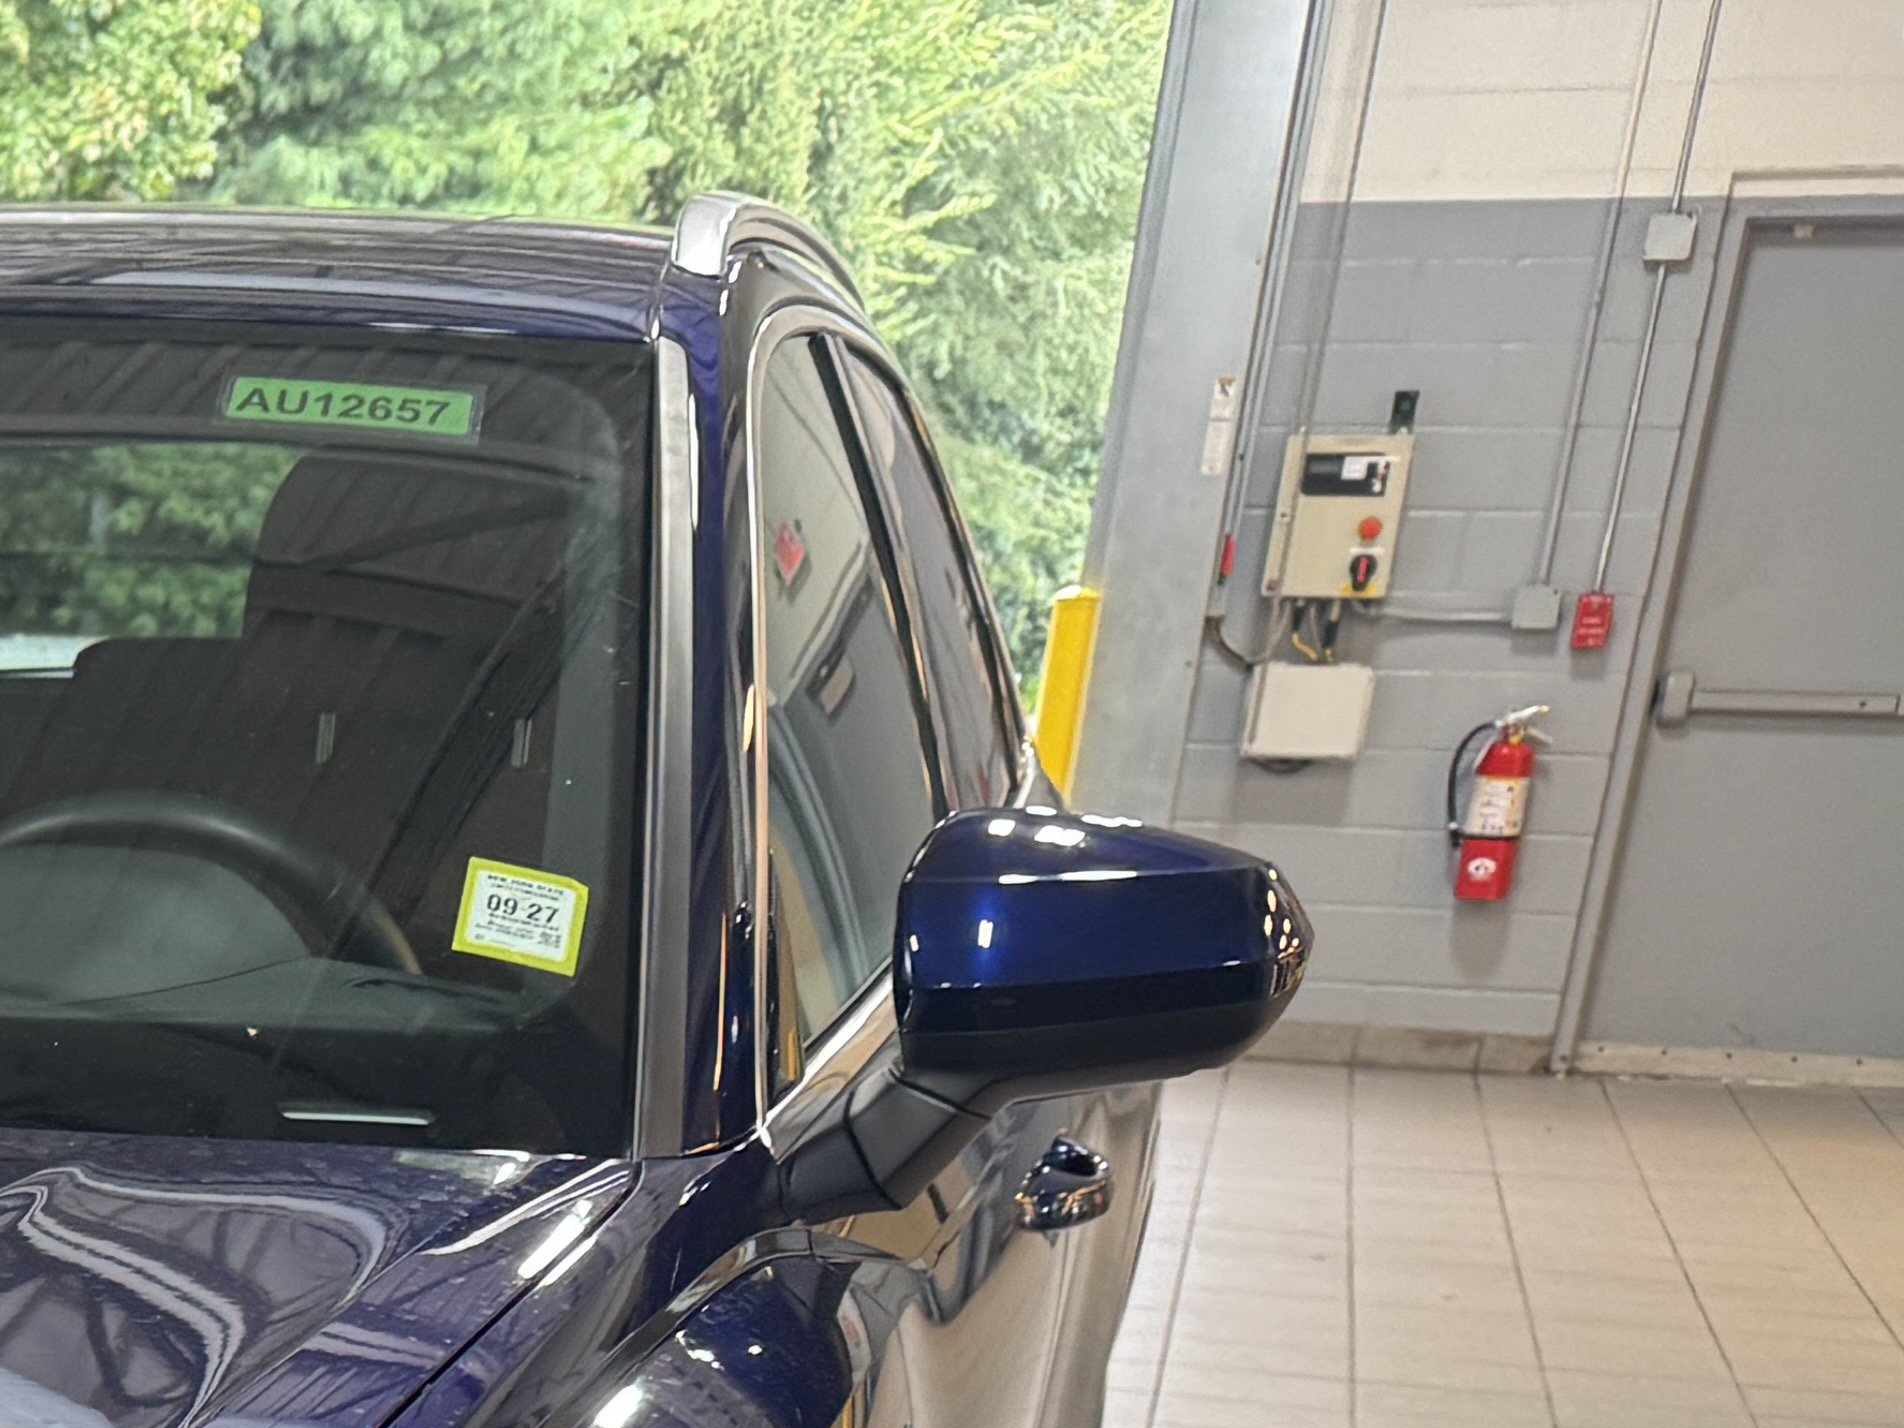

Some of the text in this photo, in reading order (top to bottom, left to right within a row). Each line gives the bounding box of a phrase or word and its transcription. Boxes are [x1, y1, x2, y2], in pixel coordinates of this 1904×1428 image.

[236, 387, 451, 426] AU12657
[487, 894, 518, 916] 09
[527, 903, 559, 924] 27
